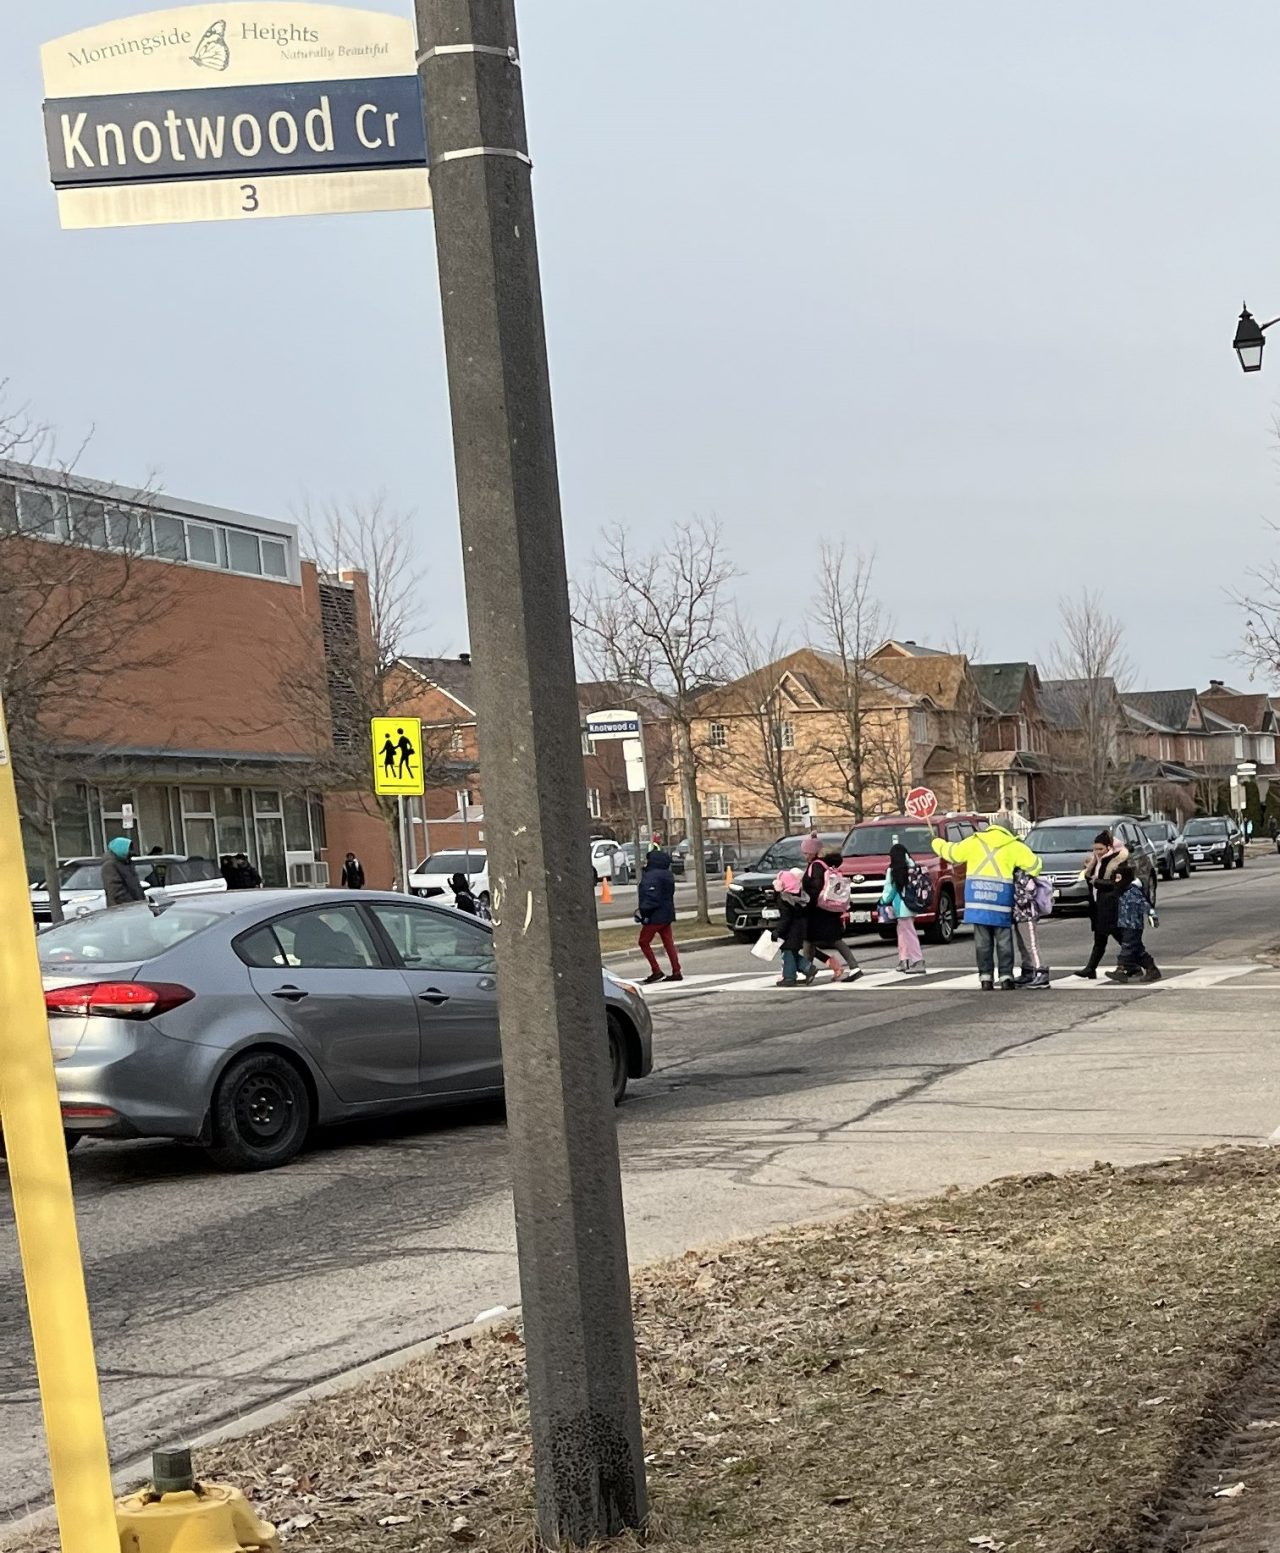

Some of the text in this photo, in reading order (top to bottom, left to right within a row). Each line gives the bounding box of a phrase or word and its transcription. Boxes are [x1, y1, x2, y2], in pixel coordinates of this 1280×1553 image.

[67, 22, 319, 68] Morningside Heights
[280, 42, 389, 61] Naturally Beautiful
[60, 95, 400, 170] Knotwood Cr
[239, 184, 259, 212] 3
[590, 723, 627, 731] Knotwood
[908, 793, 933, 813] STOP
[974, 891, 997, 901] GUARD
